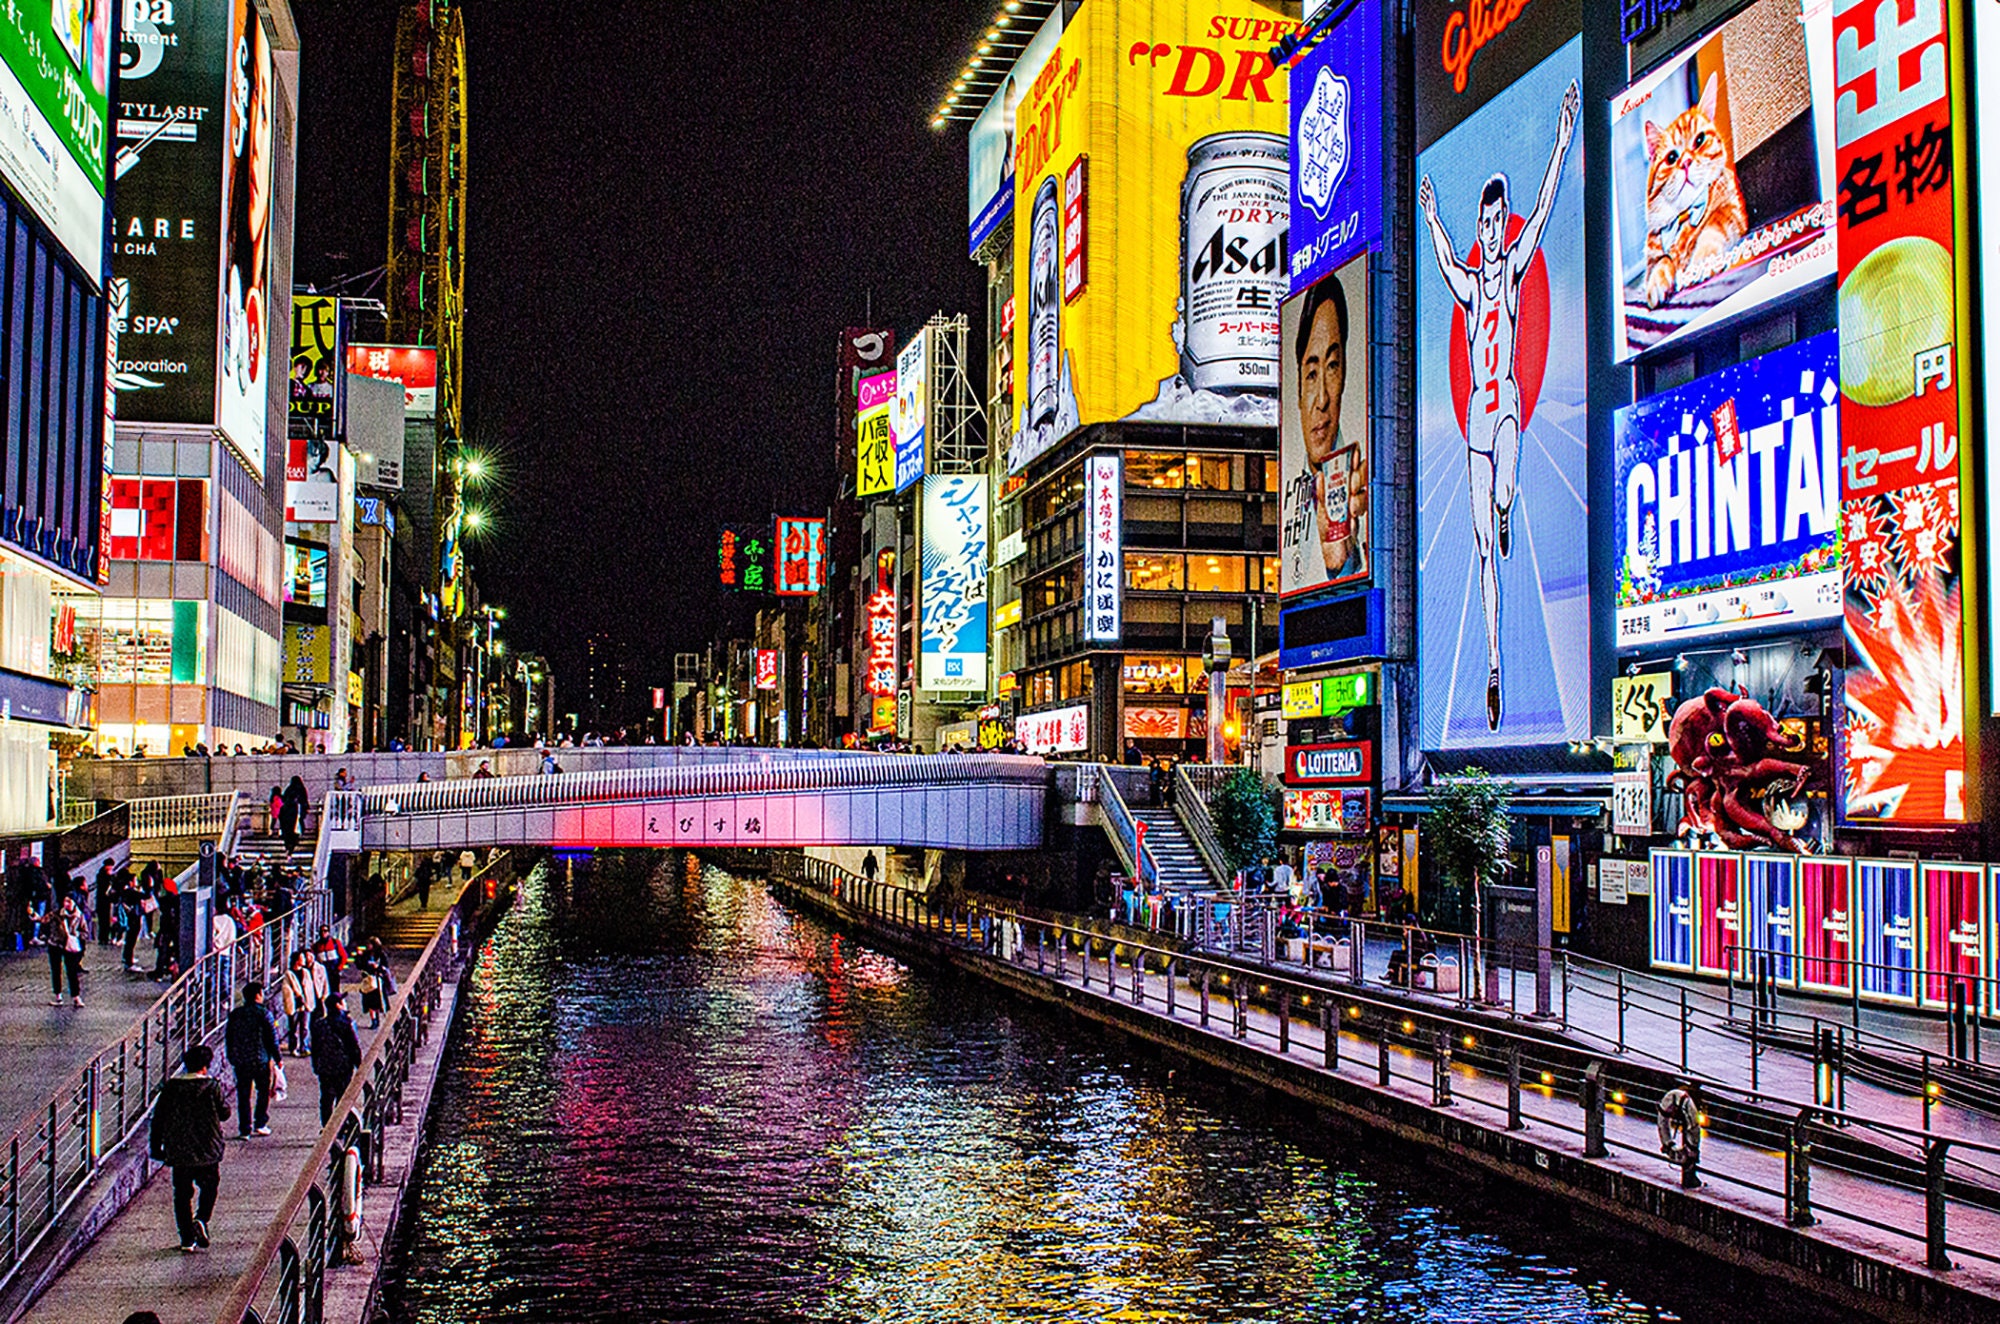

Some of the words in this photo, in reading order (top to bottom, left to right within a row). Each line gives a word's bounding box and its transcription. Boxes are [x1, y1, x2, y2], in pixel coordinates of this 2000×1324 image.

[1838, 121, 1951, 230] 名物
[1236, 285, 1273, 310] 生
[1238, 362, 1271, 376] 350ml
[1483, 300, 1500, 415] グリコ
[1913, 344, 1953, 397] 円
[860, 420, 875, 491] バイト
[874, 414, 889, 488] 高収入
[1842, 421, 1958, 491] セール
[1626, 404, 1839, 576] CHINTAI
[1848, 511, 1880, 571] 激安
[869, 589, 896, 693] 大阪王将
[947, 662, 962, 673] BX
[1308, 750, 1357, 774] LOTTERIA
[646, 815, 763, 836] えびす橋
